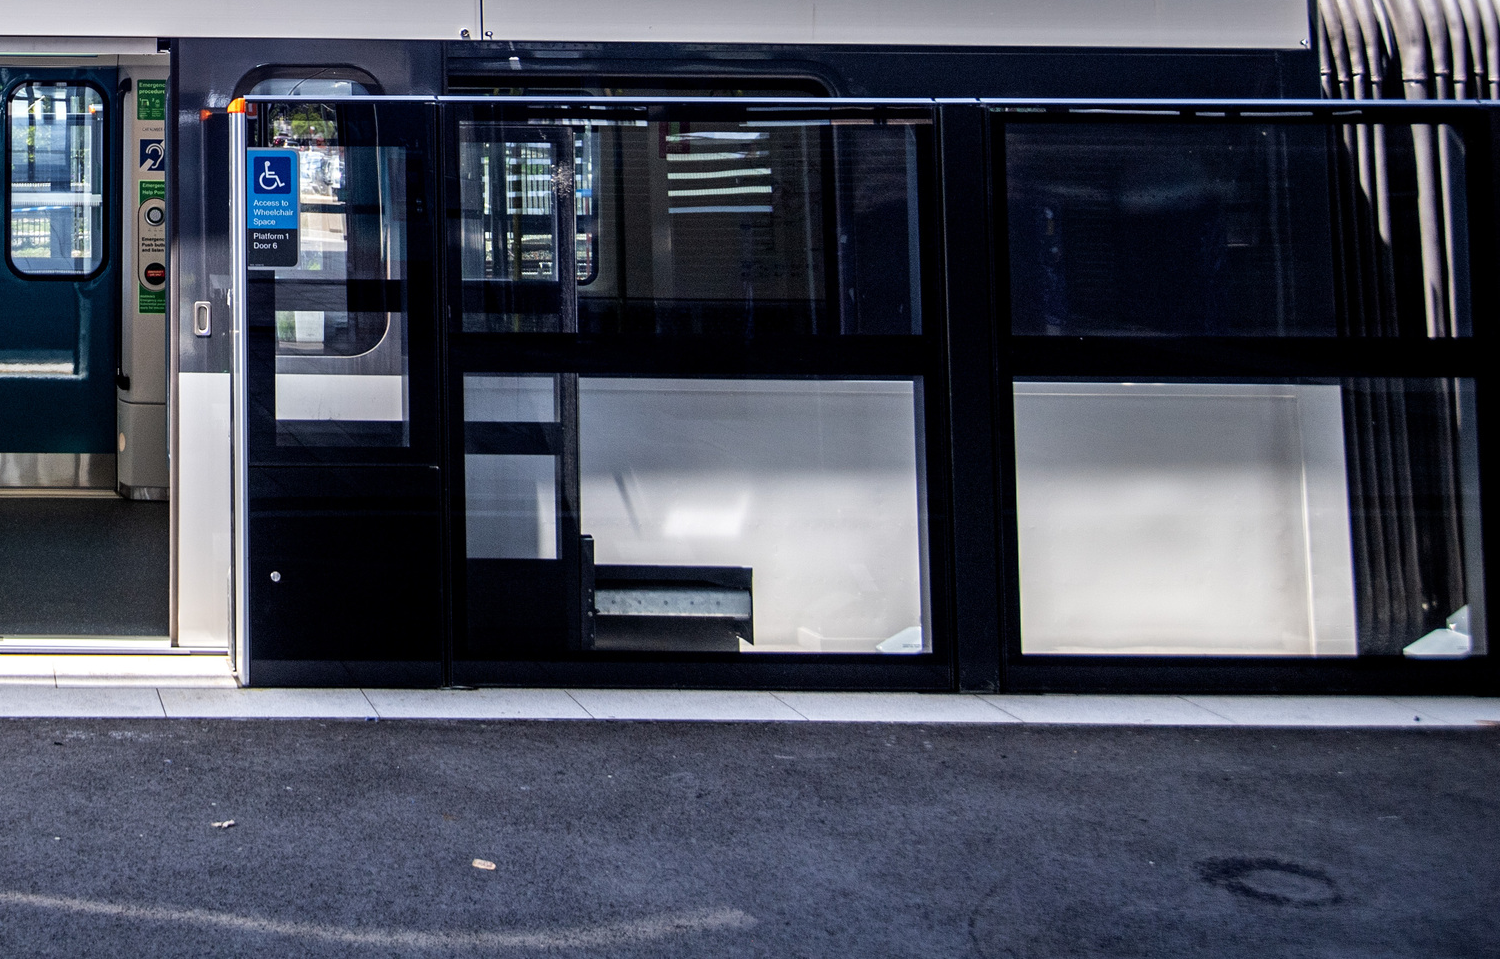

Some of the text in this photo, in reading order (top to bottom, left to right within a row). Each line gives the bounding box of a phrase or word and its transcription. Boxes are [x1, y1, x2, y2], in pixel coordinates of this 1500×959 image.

[253, 199, 289, 207] Access to
[253, 208, 294, 216] Wheelchair
[253, 217, 276, 226] Space
[253, 232, 290, 240] Platform 1
